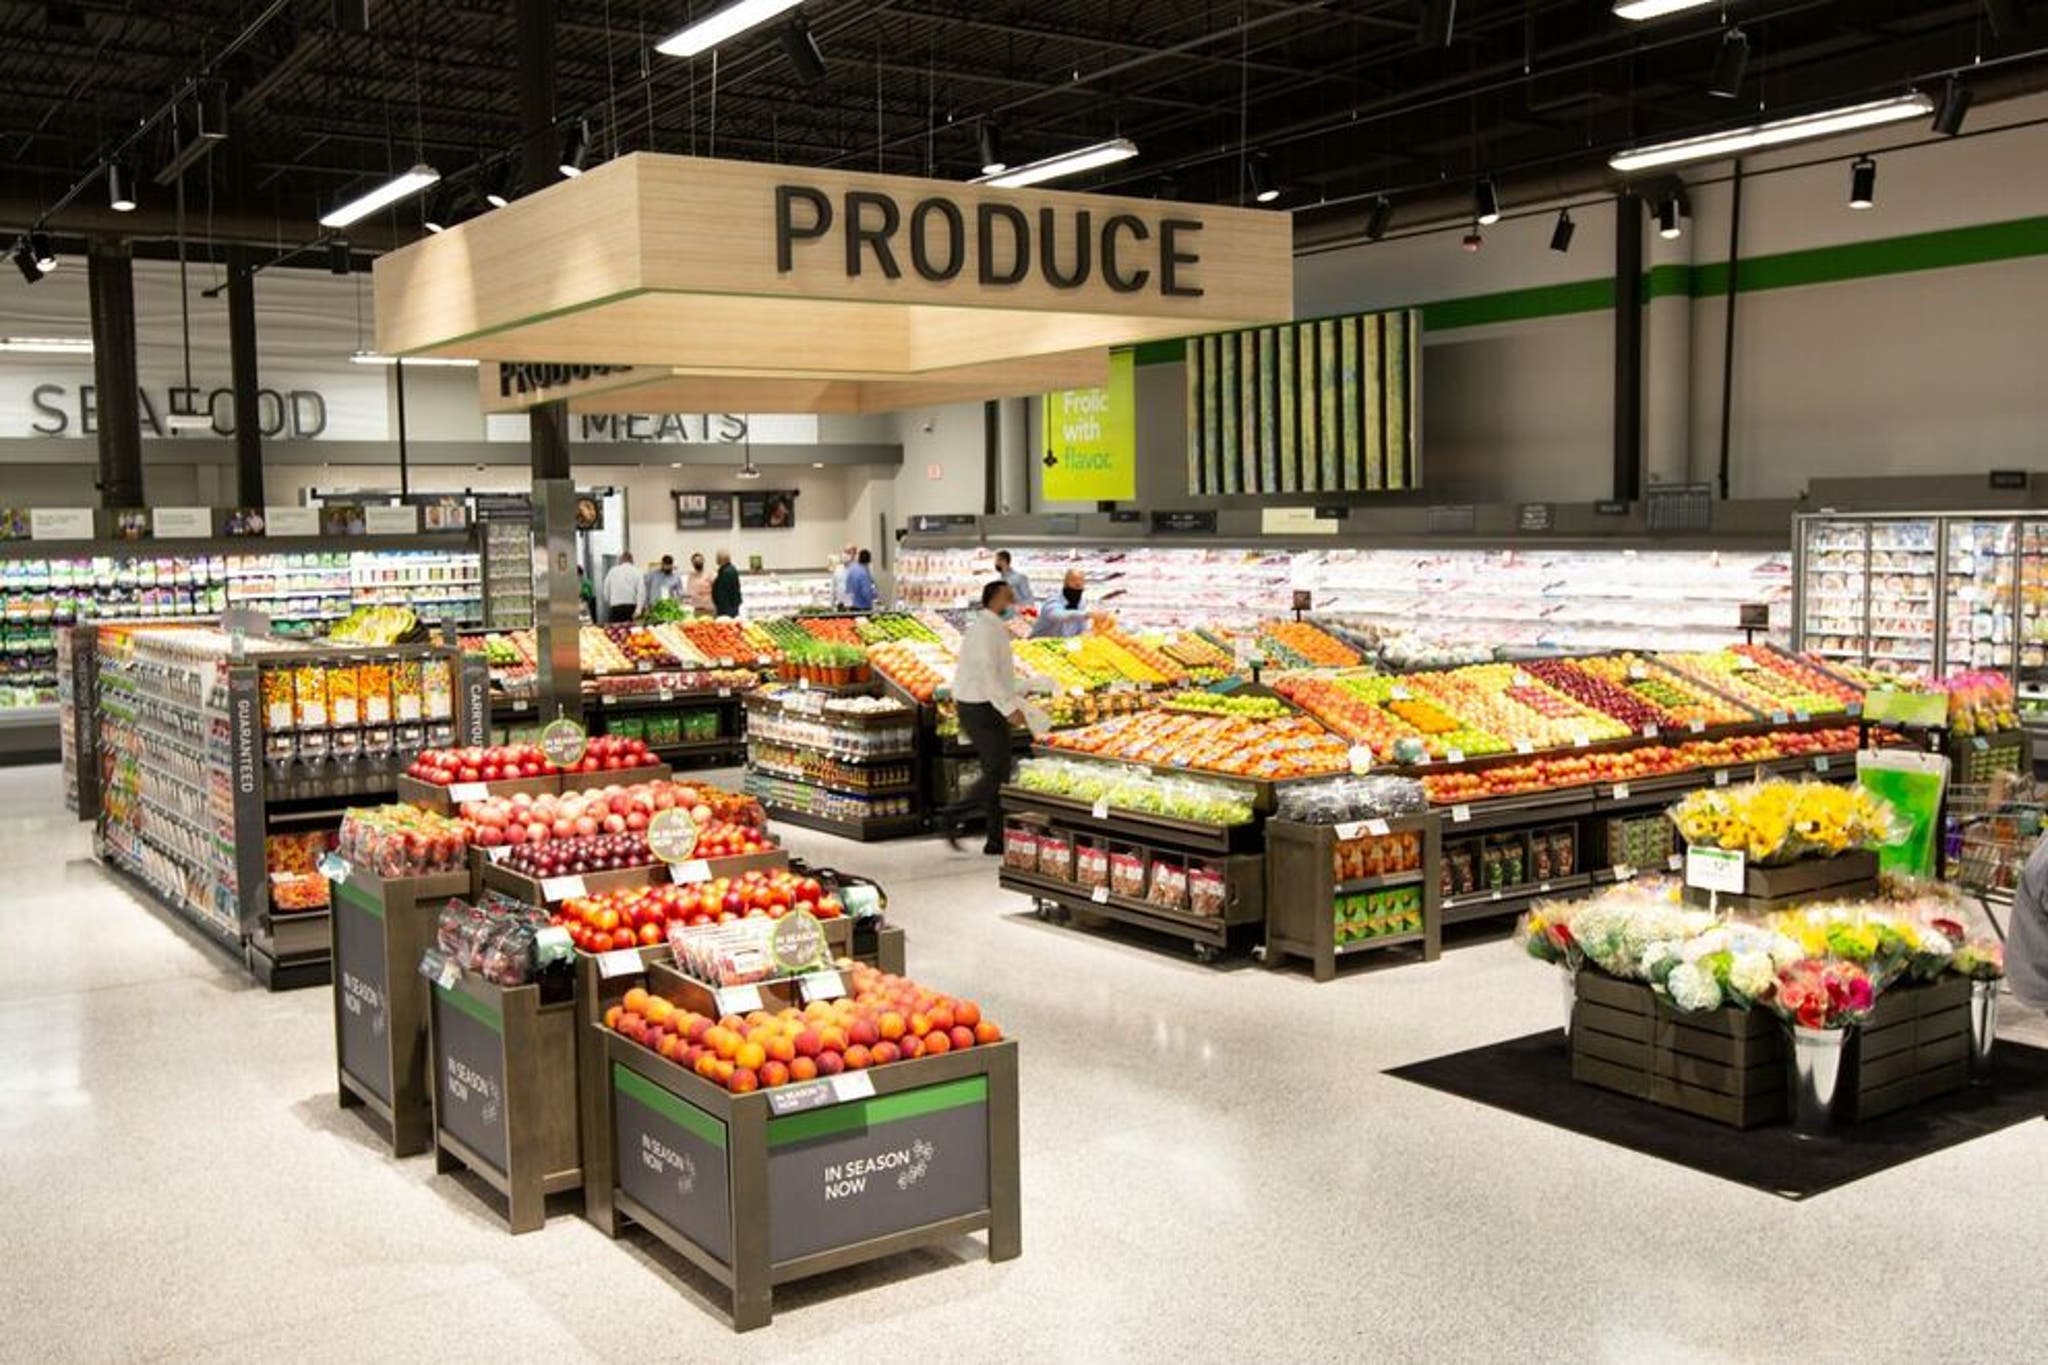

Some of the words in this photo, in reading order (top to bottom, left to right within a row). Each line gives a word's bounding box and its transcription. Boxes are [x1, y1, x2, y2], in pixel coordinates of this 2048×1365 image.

[774, 184, 1206, 297] PRODUCE
[1063, 388, 1109, 414] Frolic
[1062, 415, 1101, 442] with
[238, 700, 254, 793] GUARANTEED
[351, 976, 378, 1008] SEASON
[448, 1056, 456, 1074] IN
[456, 1062, 489, 1098] SEASON
[448, 1074, 468, 1102] NOW
[642, 1133, 651, 1149] IN
[651, 1138, 684, 1171] SEASON
[642, 1150, 663, 1173] NOW
[824, 1165, 842, 1183] IN
[845, 1149, 911, 1178] SEASON
[824, 1177, 867, 1201] NOW
